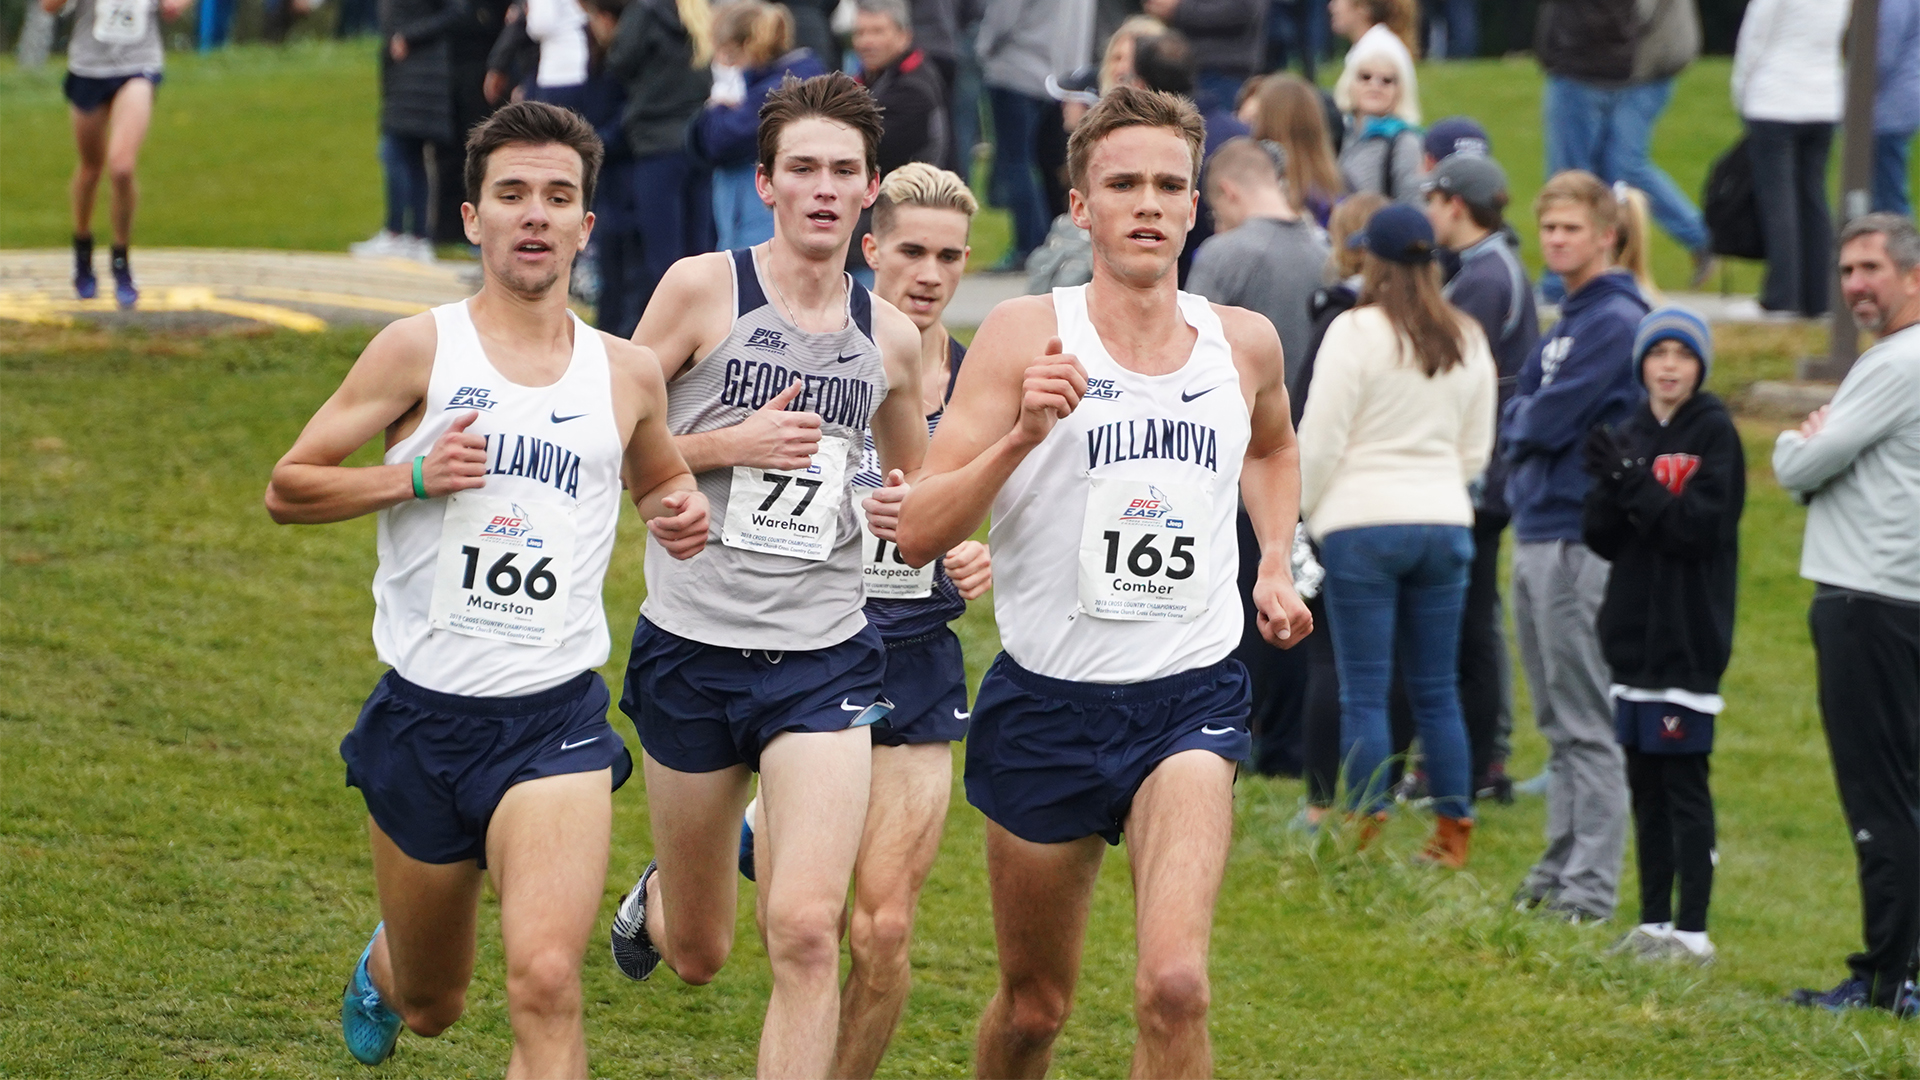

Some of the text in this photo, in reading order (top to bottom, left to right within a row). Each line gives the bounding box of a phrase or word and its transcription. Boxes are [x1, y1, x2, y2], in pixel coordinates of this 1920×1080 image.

[753, 327, 783, 340] BIG
[747, 336, 790, 350] EAST
[1087, 378, 1115, 389] BIG
[456, 386, 491, 398] BIG
[449, 396, 498, 410] EAST
[1087, 418, 1218, 473] VILLANOVA
[757, 473, 823, 516] 77
[1129, 498, 1161, 509] BIG
[1123, 508, 1168, 519] EAST
[490, 515, 523, 527] BIG
[752, 513, 819, 535] Wareham
[483, 525, 529, 537] EAST
[1103, 530, 1195, 581] 165
[461, 545, 557, 601] 166
[864, 564, 921, 579] akepeace
[1112, 578, 1174, 595] Comber
[467, 594, 534, 616] Marston
[1146, 603, 1187, 611] CHAMPIONSHIPS
[462, 615, 478, 624] CROSS
[480, 618, 504, 627] COUNTRY
[505, 623, 545, 633] CHAMPIONSHIPS
[507, 631, 525, 639] Country
